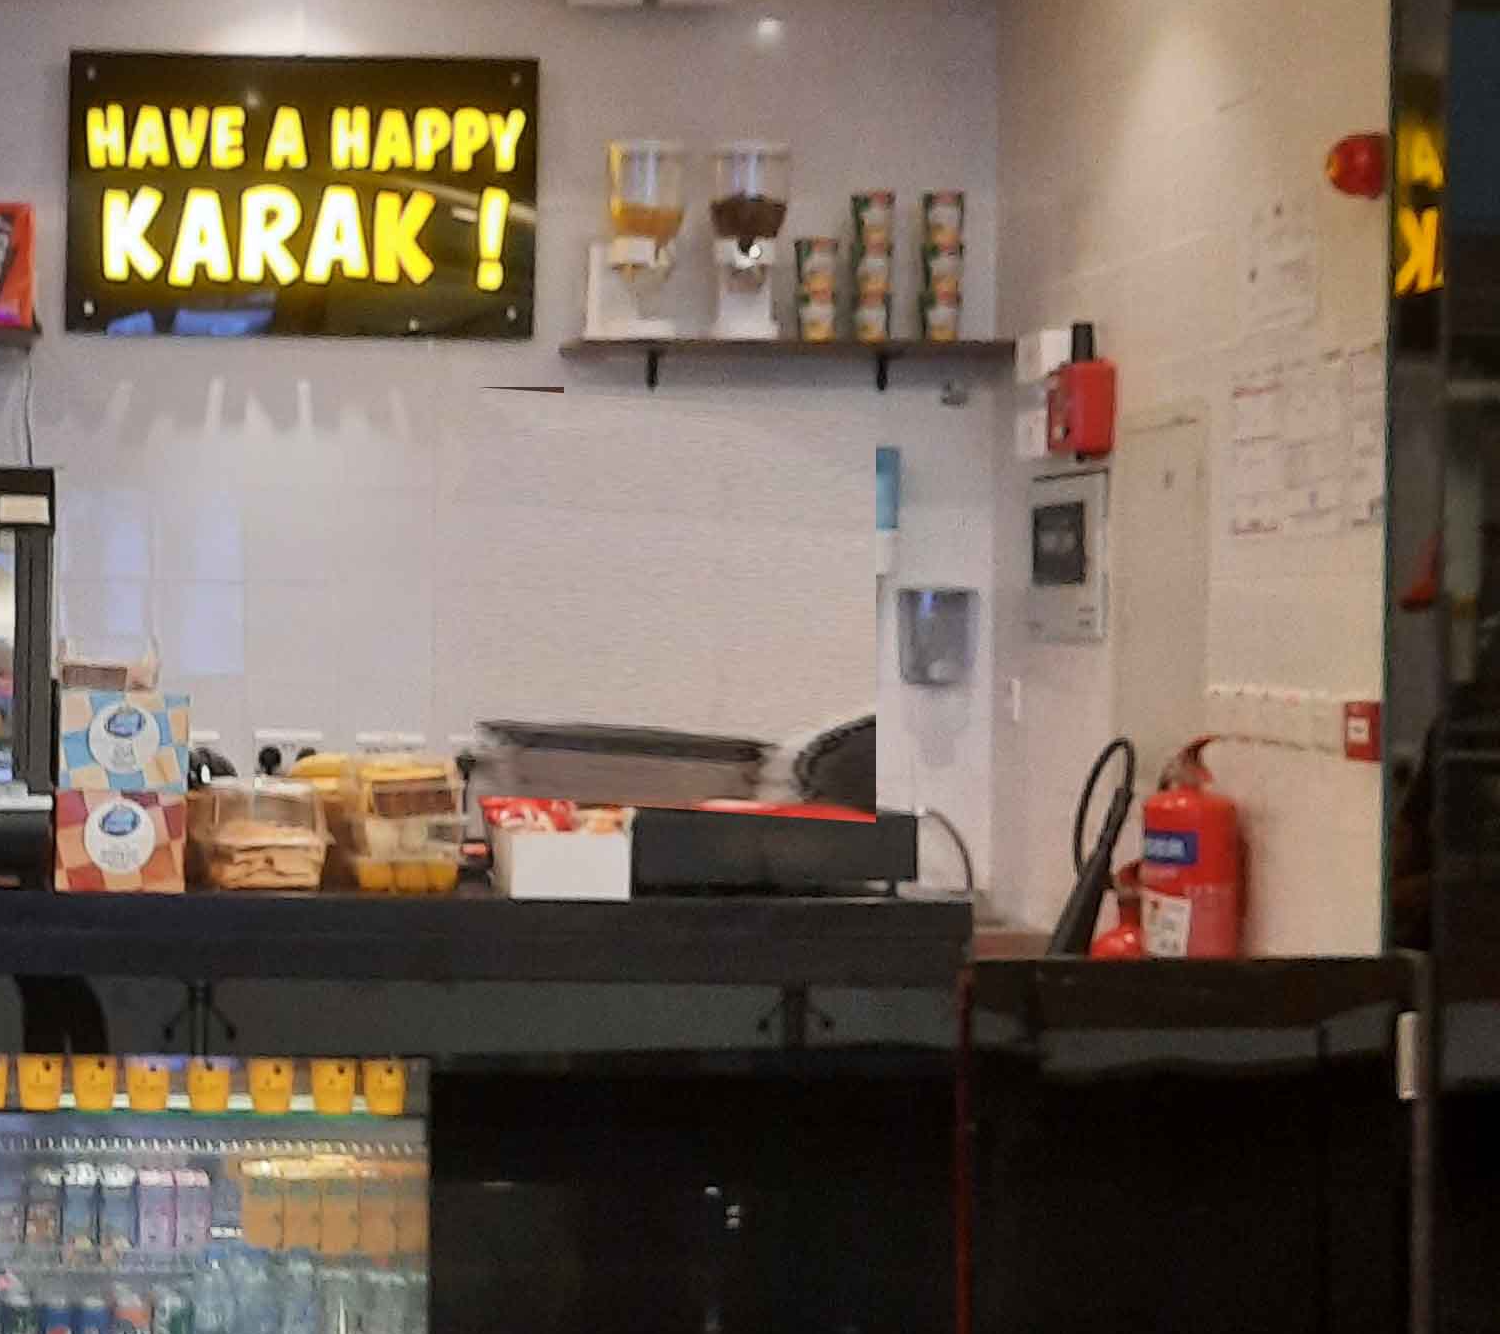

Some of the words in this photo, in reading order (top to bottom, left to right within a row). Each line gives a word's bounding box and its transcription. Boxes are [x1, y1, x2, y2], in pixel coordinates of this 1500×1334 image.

[85, 103, 246, 170] HAVE
[262, 105, 308, 172] A
[329, 105, 527, 172] HAPPY
[101, 184, 437, 288] KARAK
[476, 186, 510, 291] !
